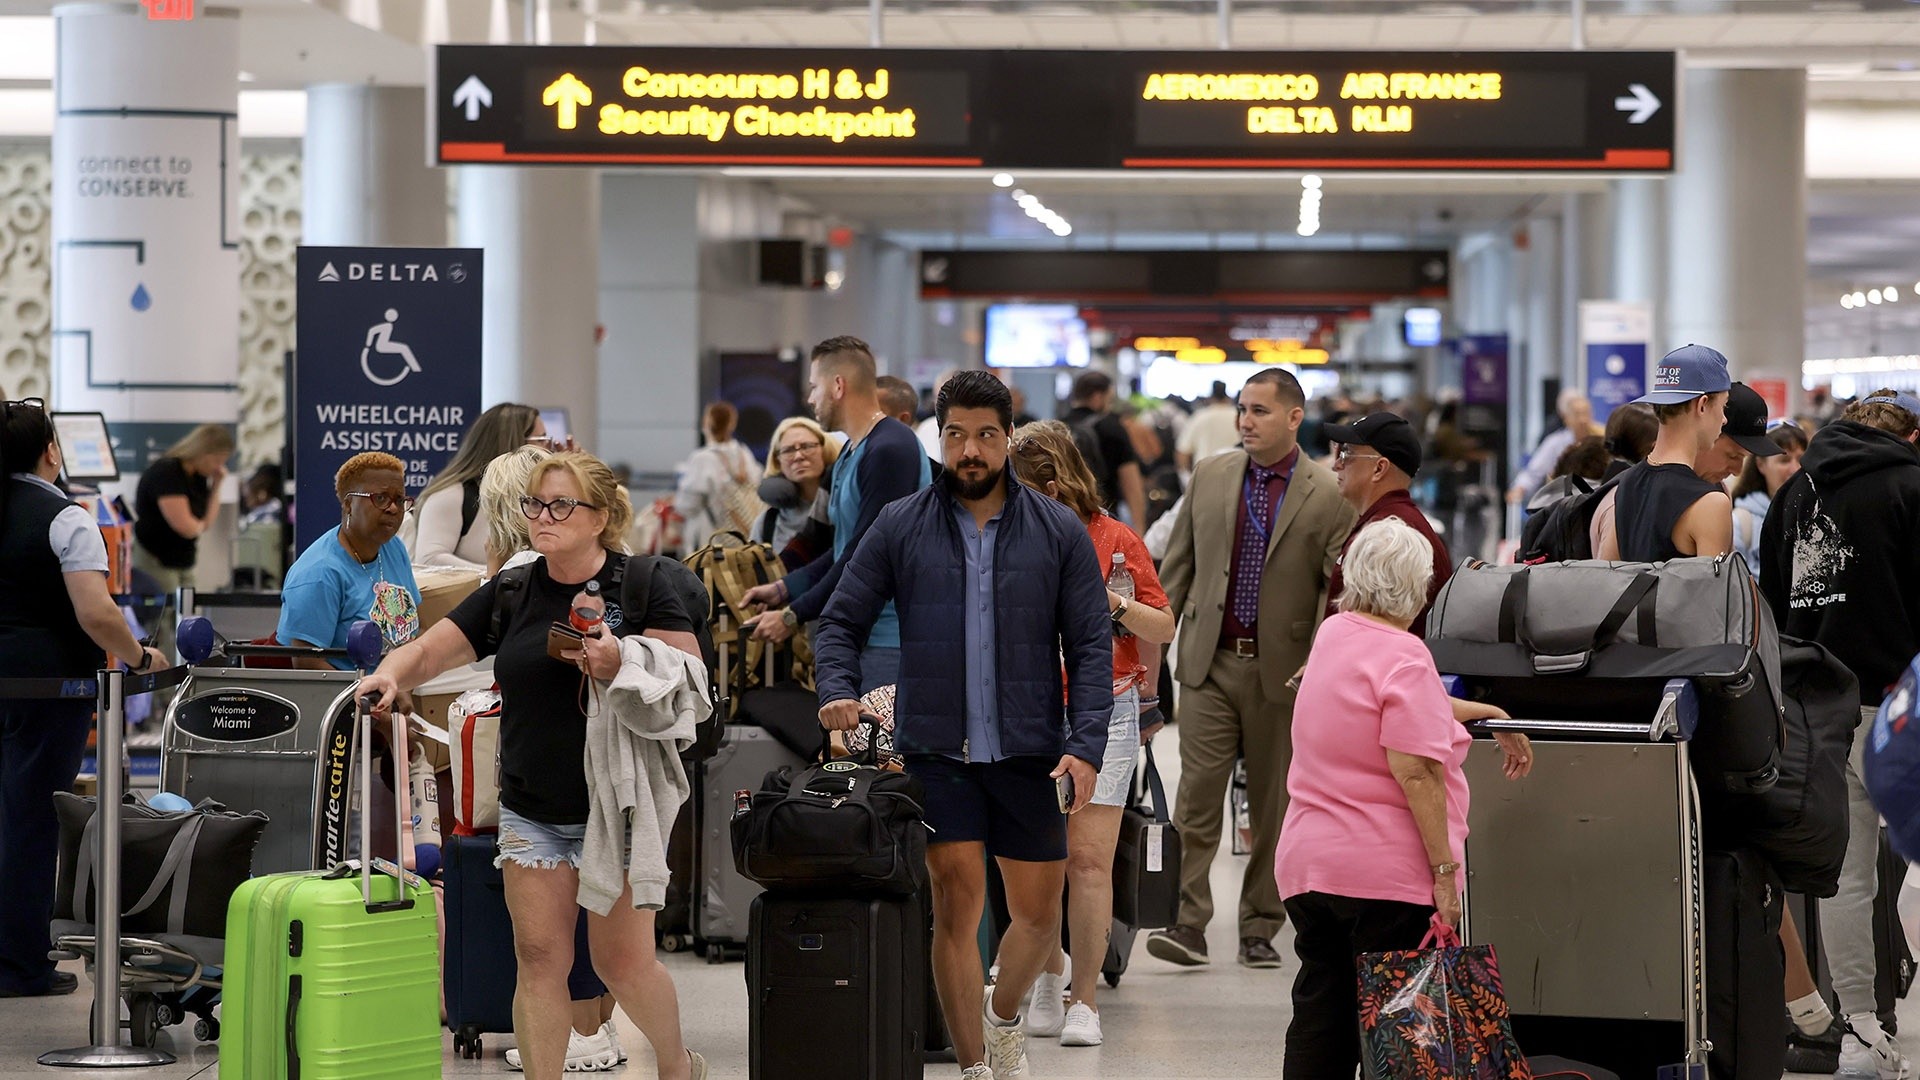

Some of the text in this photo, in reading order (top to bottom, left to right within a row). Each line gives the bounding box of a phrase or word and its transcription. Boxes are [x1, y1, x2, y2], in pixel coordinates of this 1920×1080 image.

[623, 66, 888, 99] Concourse H & J
[1143, 74, 1318, 100] AEROMEXICO
[1340, 73, 1501, 99] AIR FRANCE
[599, 103, 915, 142] Security Checkpoint
[1248, 106, 1411, 133] DELTA KLM
[79, 156, 192, 174] connect to
[348, 263, 439, 282] DELTA
[1669, 367, 1680, 376] OF
[316, 404, 464, 425] WHEELCHAIR
[320, 430, 459, 451] ASSISTANCE
[410, 460, 428, 473] DE
[1790, 597, 1813, 609] WAY
[210, 705, 257, 715] Welcome to
[212, 716, 251, 729] Miami
[325, 734, 347, 871] martecarte
